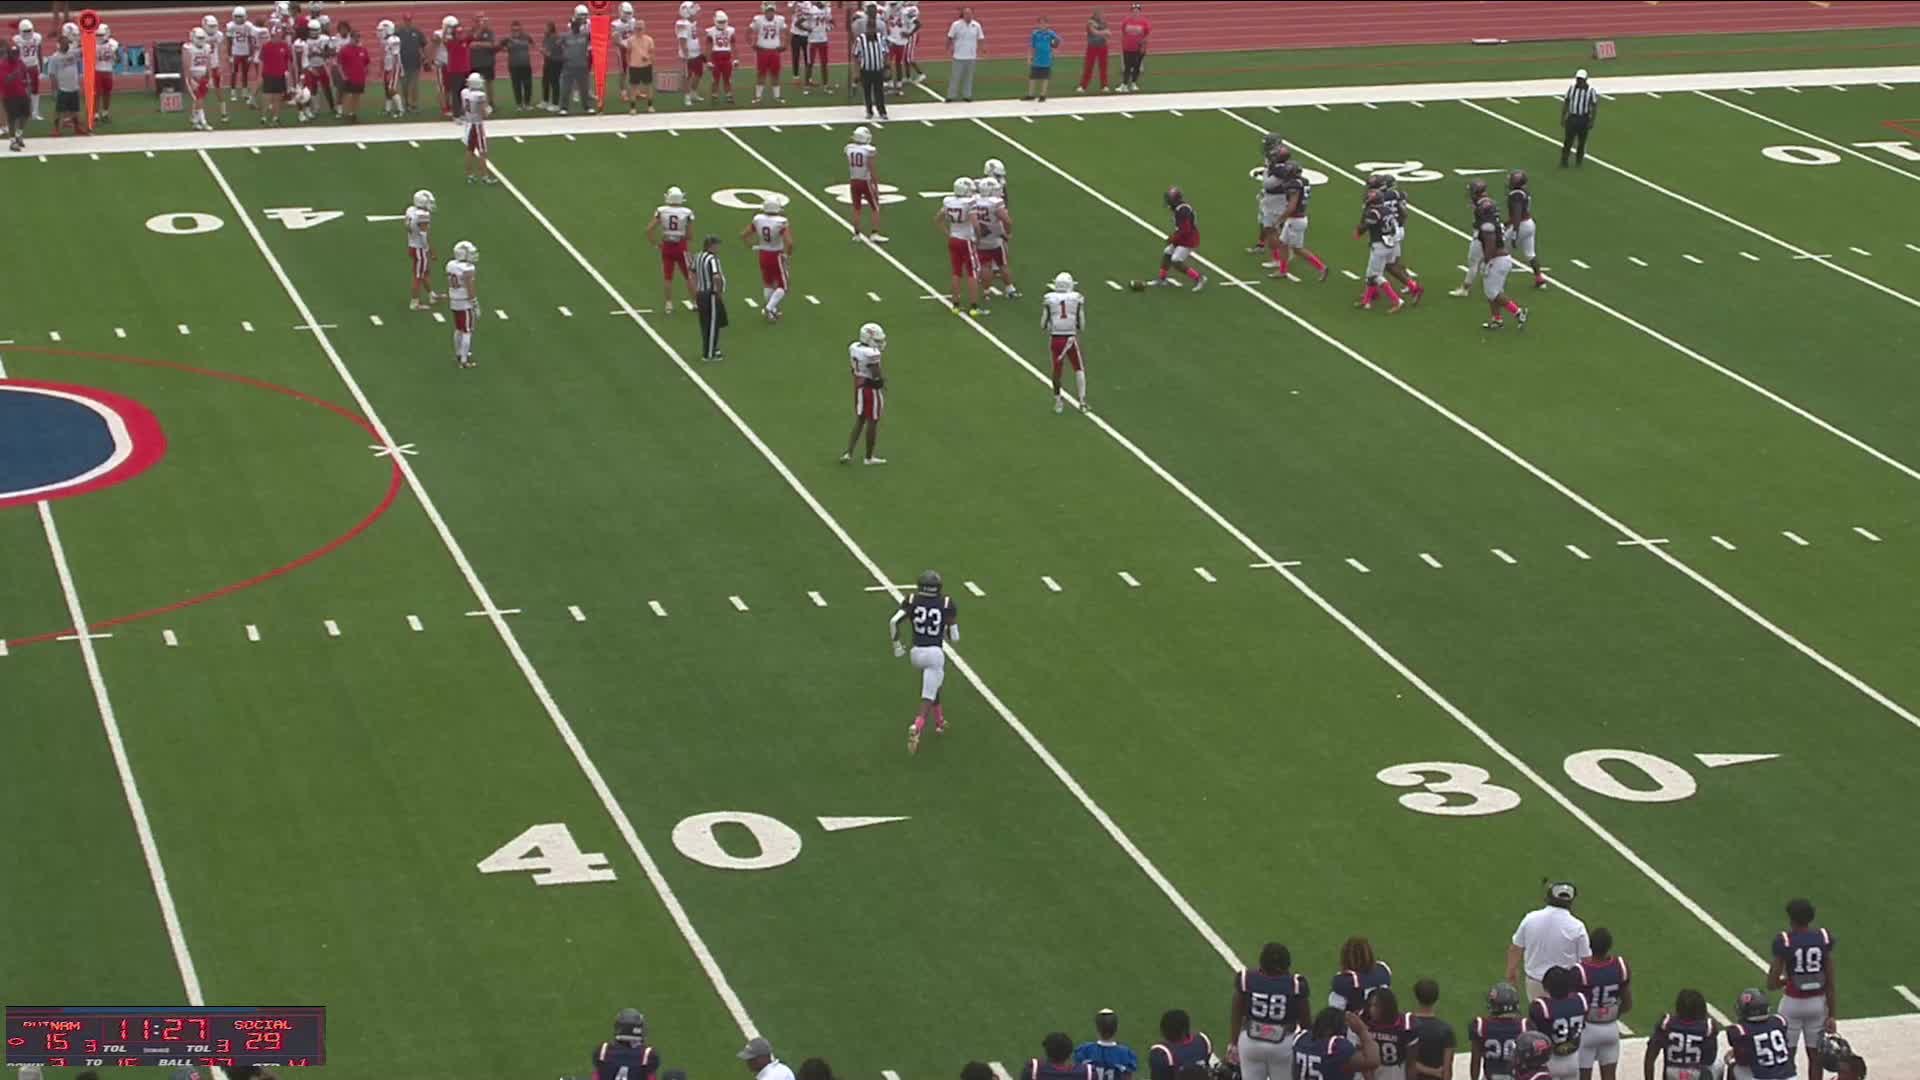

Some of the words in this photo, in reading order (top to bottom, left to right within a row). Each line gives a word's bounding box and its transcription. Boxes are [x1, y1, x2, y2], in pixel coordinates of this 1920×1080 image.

[850, 152, 864, 168] 10
[669, 215, 678, 231] 6
[762, 227, 771, 242] 9
[1060, 301, 1068, 319] 1
[913, 606, 942, 636] 23
[1795, 947, 1821, 973] 18
[1591, 984, 1619, 1008] 15
[1552, 1016, 1584, 1044] 37
[1667, 1032, 1703, 1064] 25
[1753, 1028, 1789, 1067] 59
